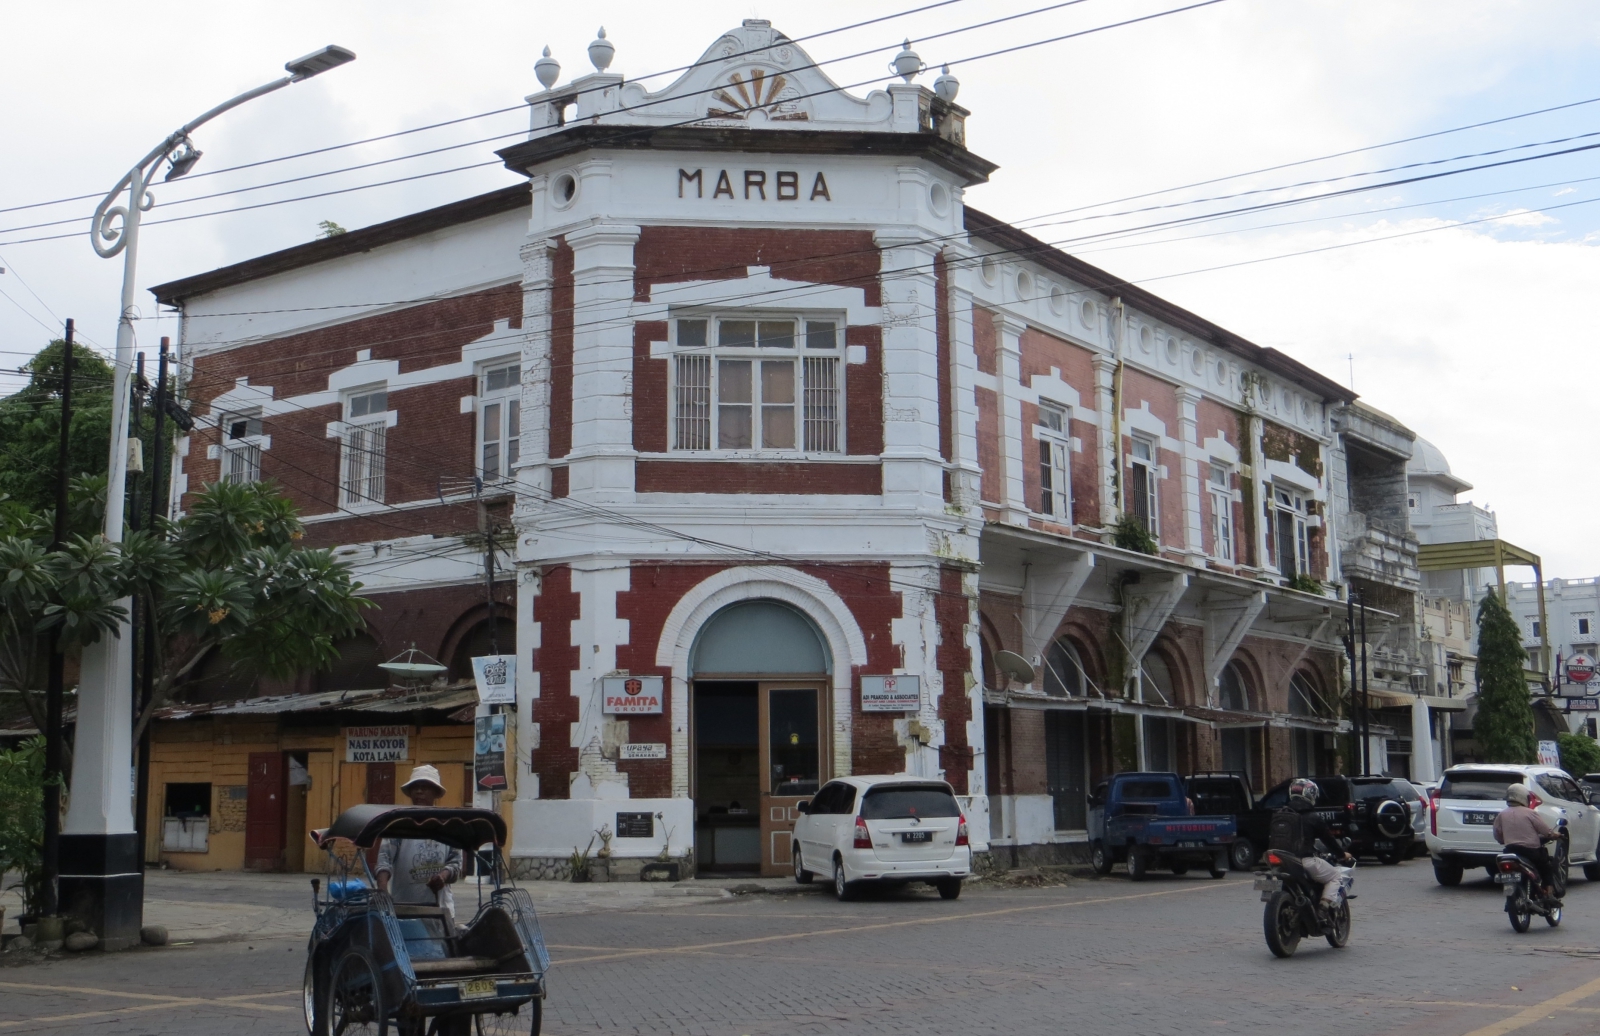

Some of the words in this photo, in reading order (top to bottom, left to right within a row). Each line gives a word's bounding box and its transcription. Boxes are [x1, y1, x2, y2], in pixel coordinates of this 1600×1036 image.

[678, 168, 831, 202] MARBA
[607, 696, 658, 706] FAMITA
[348, 727, 378, 737] WARUNG
[380, 726, 408, 737] MAKAN
[349, 740, 371, 749] NASI
[373, 739, 406, 749] KOYOR
[353, 752, 376, 761] KOTA
[378, 752, 401, 761] LAMA
[468, 981, 493, 992] 2609
